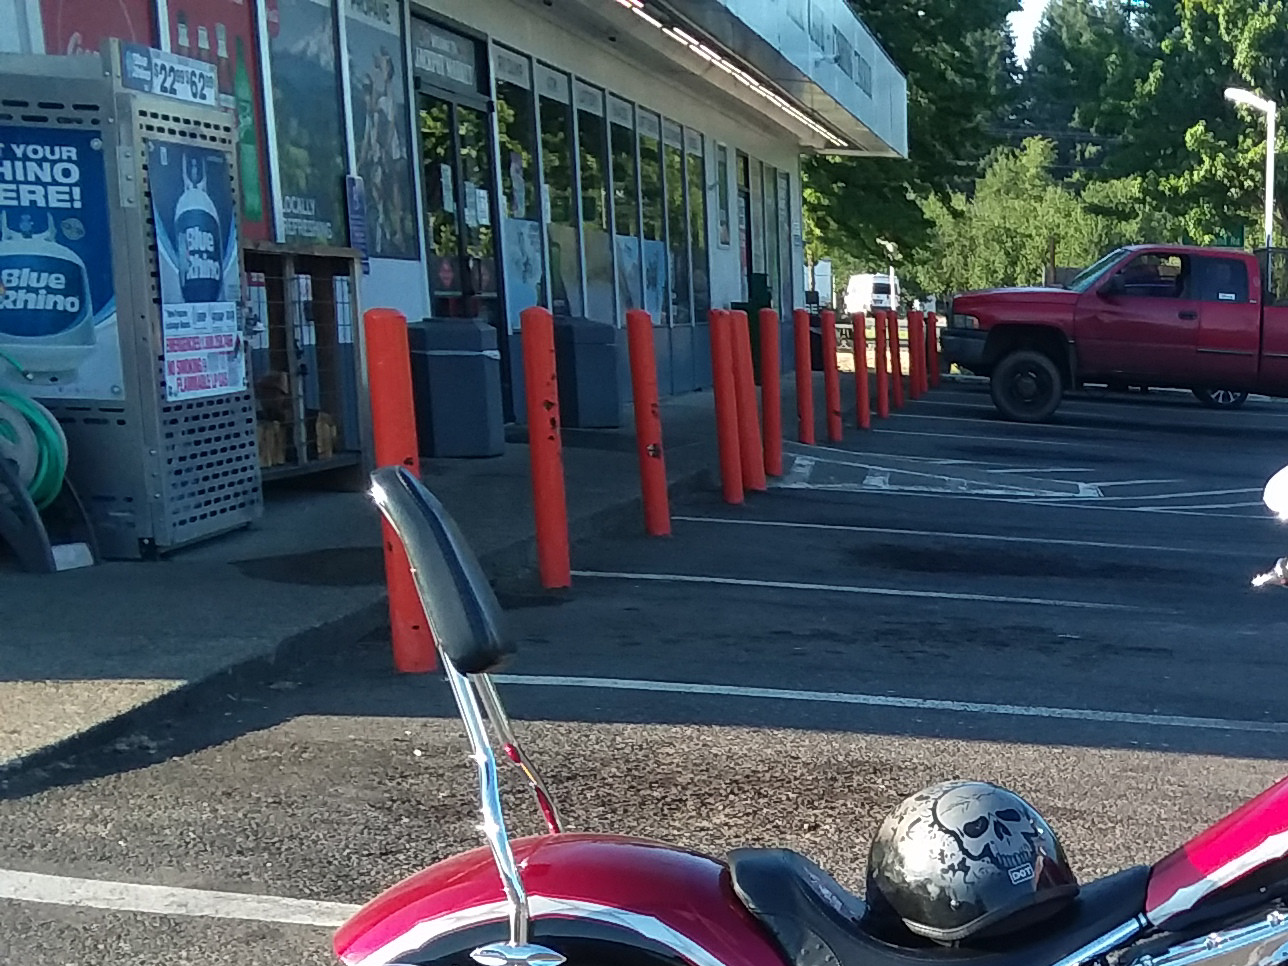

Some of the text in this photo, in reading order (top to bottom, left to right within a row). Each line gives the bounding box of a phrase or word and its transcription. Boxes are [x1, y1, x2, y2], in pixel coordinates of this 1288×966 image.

[11, 143, 78, 161] YOUR
[186, 226, 215, 252] Blue
[1, 267, 66, 289] Blue
[0, 289, 80, 313] Rhino
[1012, 867, 1032, 881] DOT
